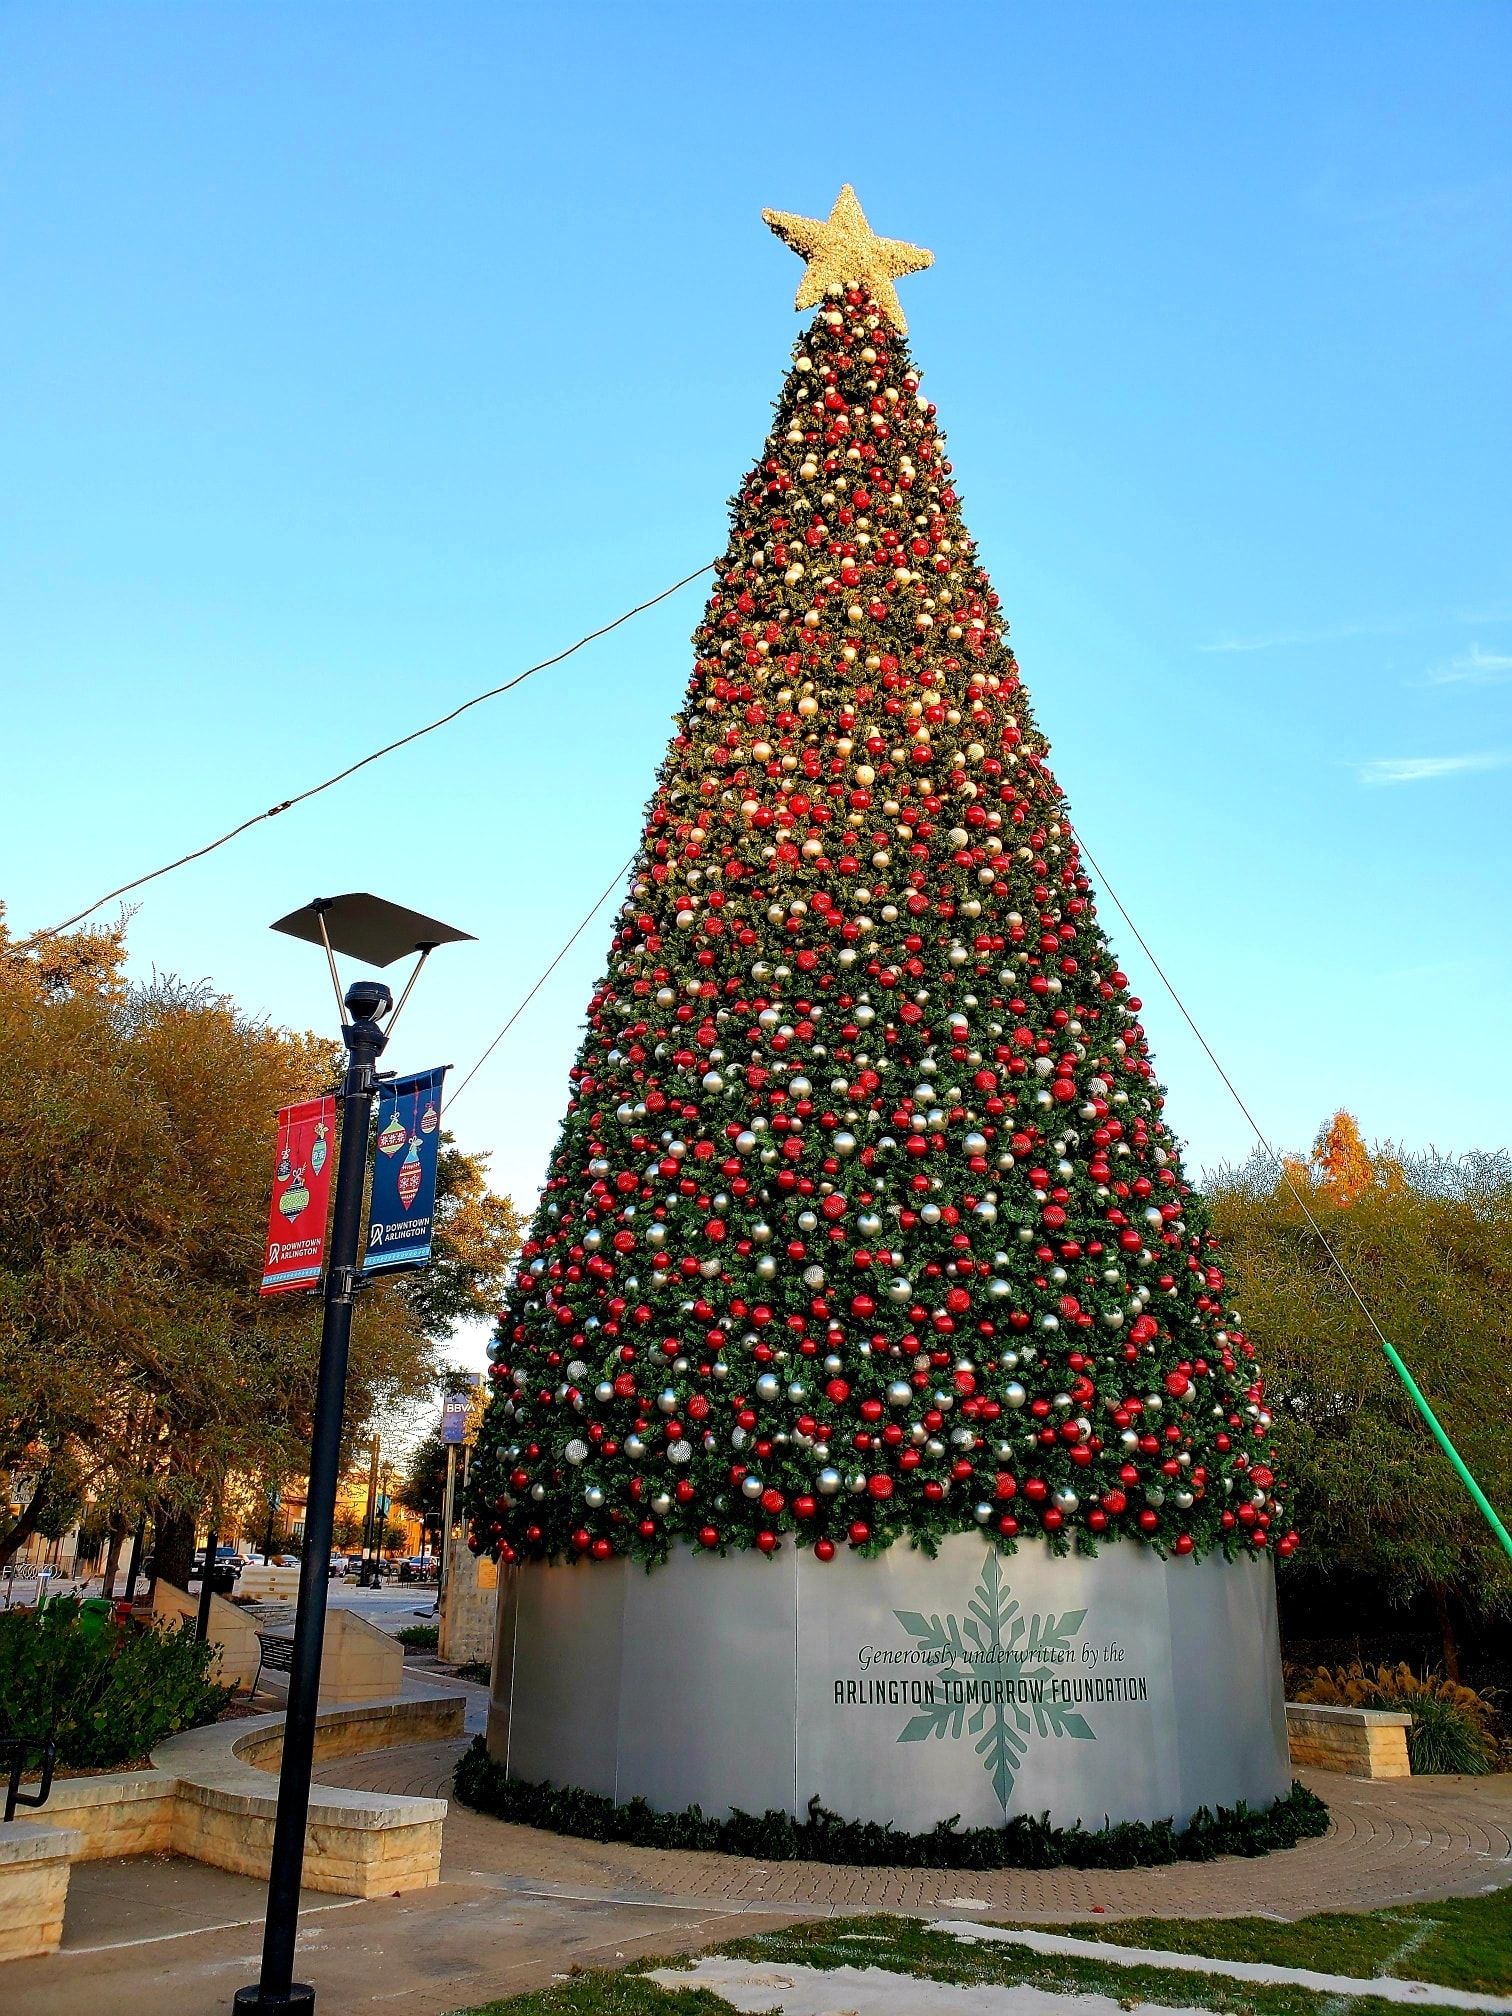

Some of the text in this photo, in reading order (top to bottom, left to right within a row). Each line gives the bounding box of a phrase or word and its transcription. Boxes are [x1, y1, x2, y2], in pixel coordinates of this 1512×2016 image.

[386, 1217, 430, 1232] DOWNTOWN
[384, 1227, 426, 1241] ARLINGTON
[281, 1238, 321, 1251] DOWNTOWN
[281, 1247, 317, 1260] ARLINGTON
[446, 1404, 476, 1413] BBVA
[858, 1641, 1125, 1671] Generously underwritten by the
[834, 1677, 1148, 1704] ARLINGTON TOMORROW FOUNDATION
